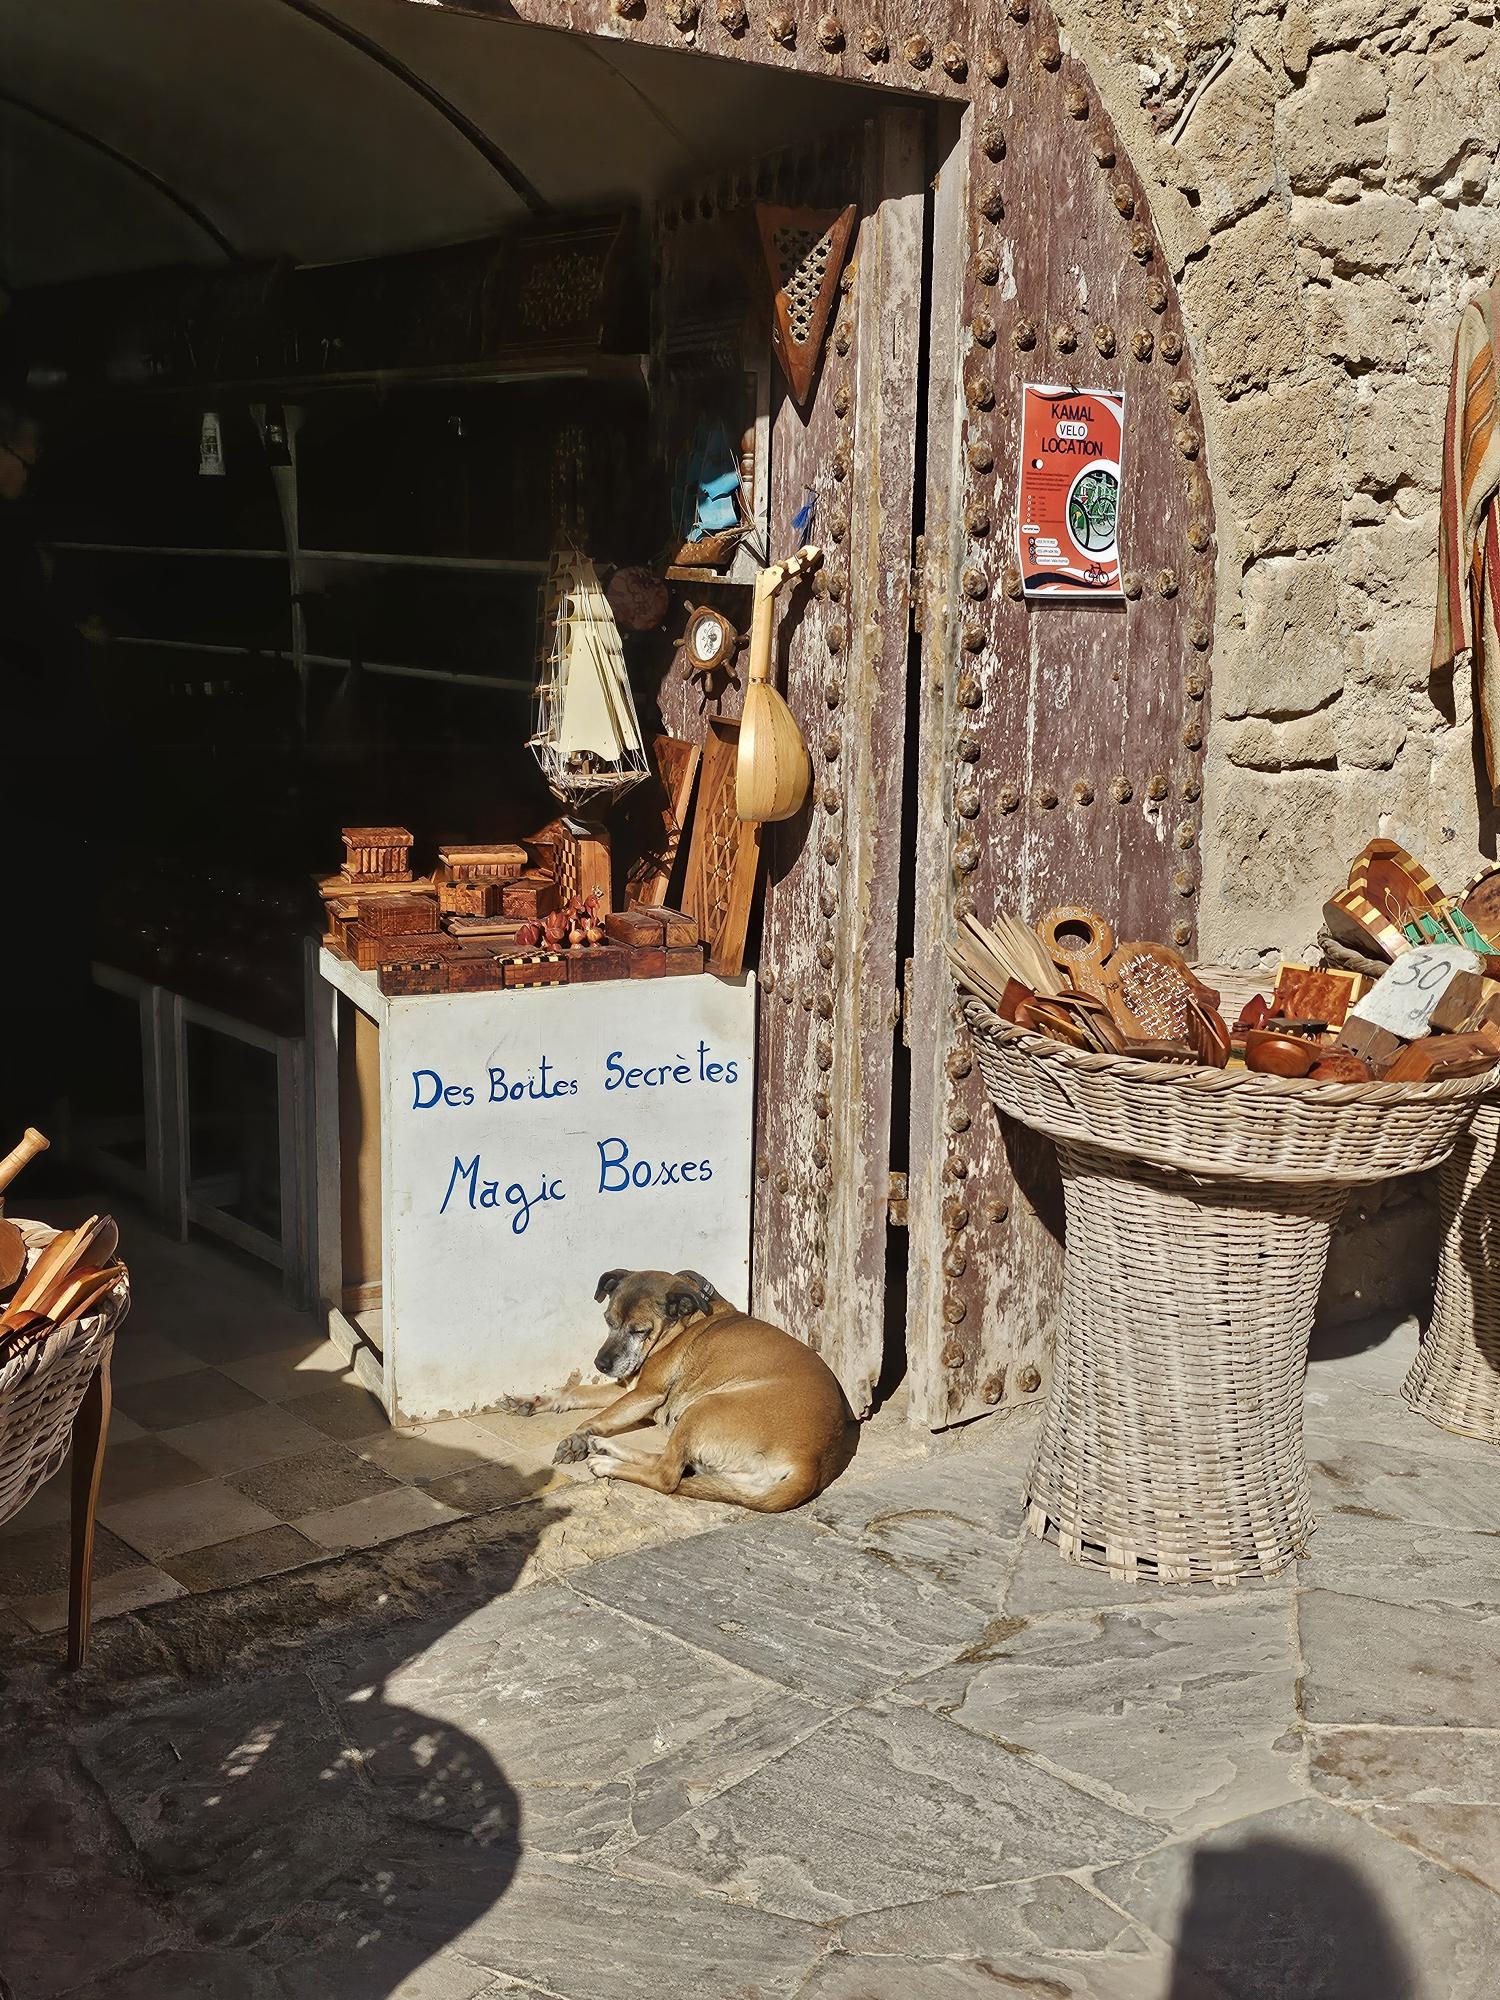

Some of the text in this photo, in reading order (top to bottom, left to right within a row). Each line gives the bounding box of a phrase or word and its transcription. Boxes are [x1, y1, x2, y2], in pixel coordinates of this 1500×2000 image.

[1051, 403, 1095, 422] KAMAL
[1059, 424, 1086, 437] VELO
[1041, 437, 1103, 456] LOCATION
[411, 1069, 476, 1110] Des
[604, 1040, 739, 1092] Secrètes
[440, 1137, 713, 1235] Magic Boxes
